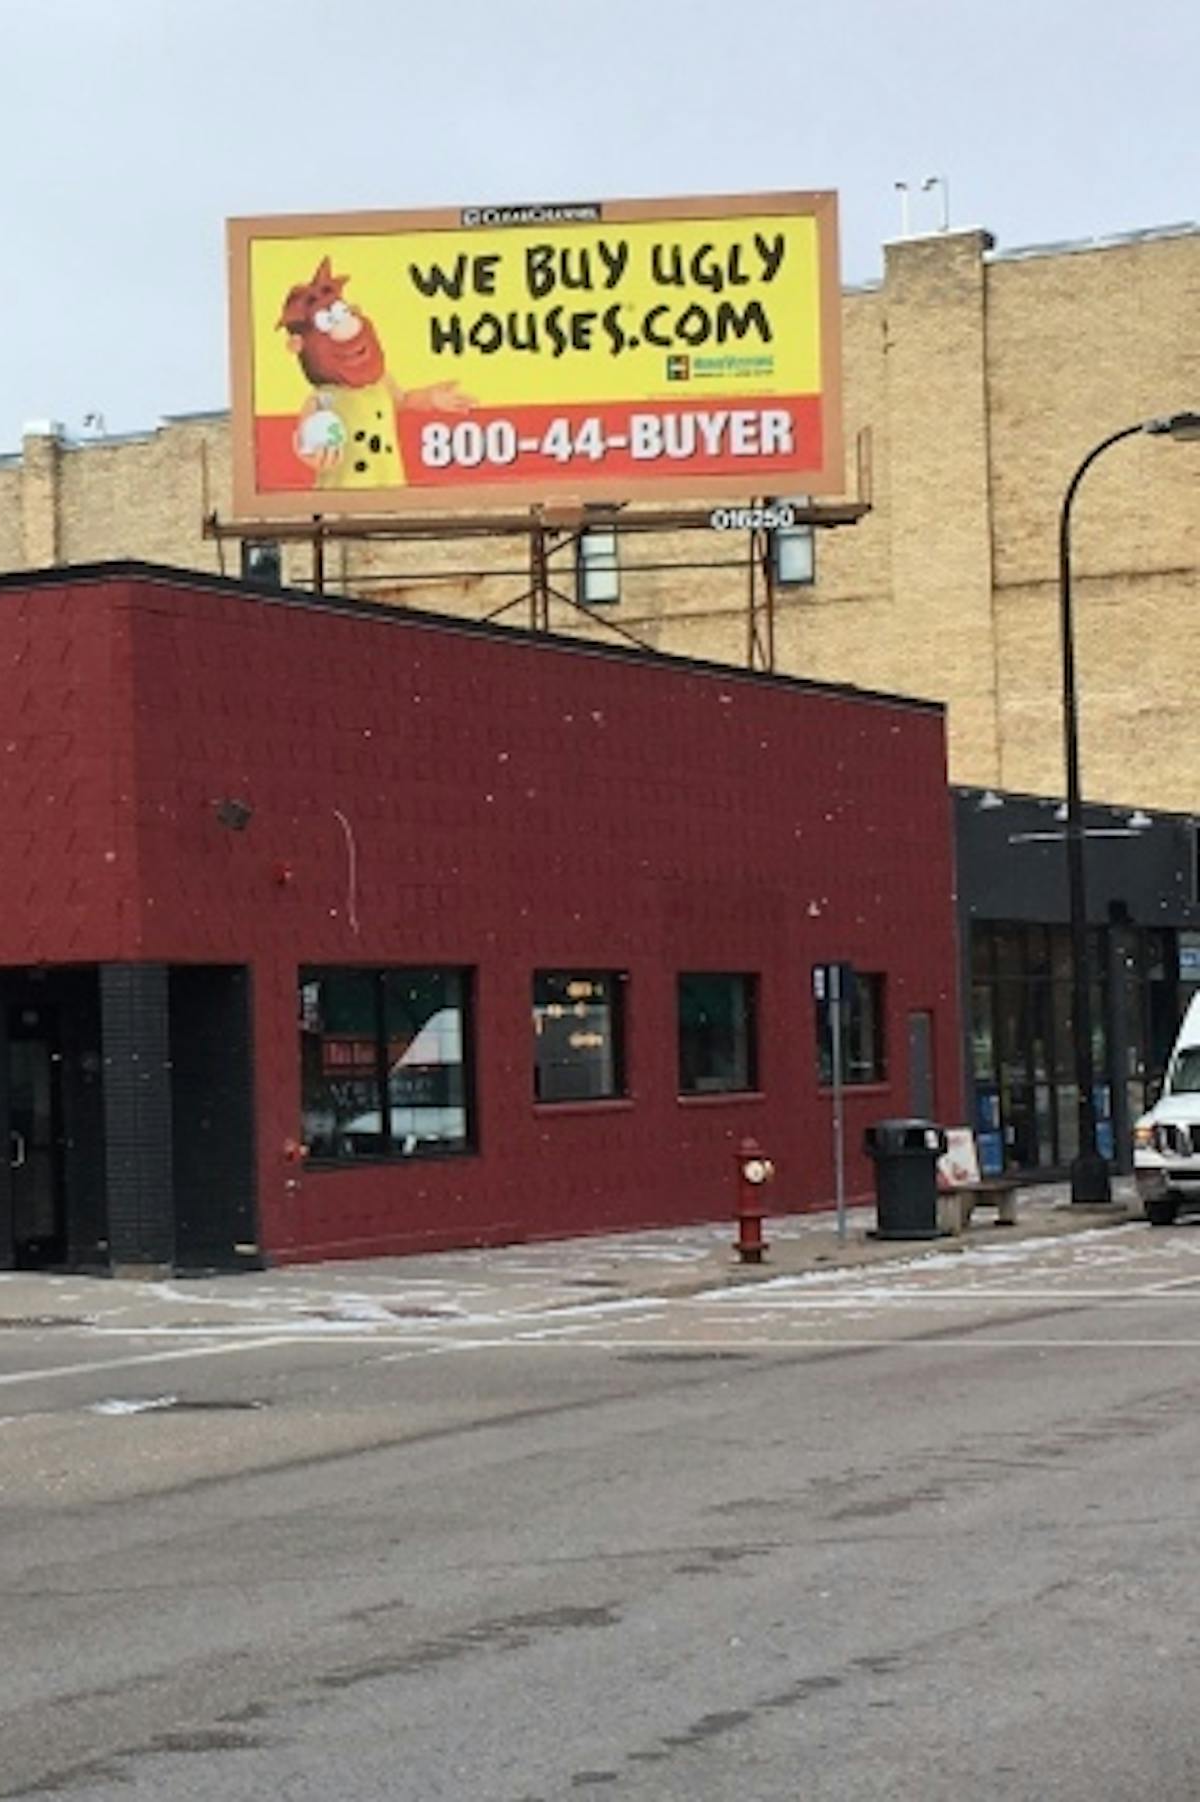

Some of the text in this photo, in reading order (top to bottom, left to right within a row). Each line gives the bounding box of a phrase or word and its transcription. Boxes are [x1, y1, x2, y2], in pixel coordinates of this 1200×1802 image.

[408, 233, 786, 301] WE BUY UGLY
[430, 301, 774, 359] HOUSES.COM
[420, 409, 794, 468] 800-44-BUYER
